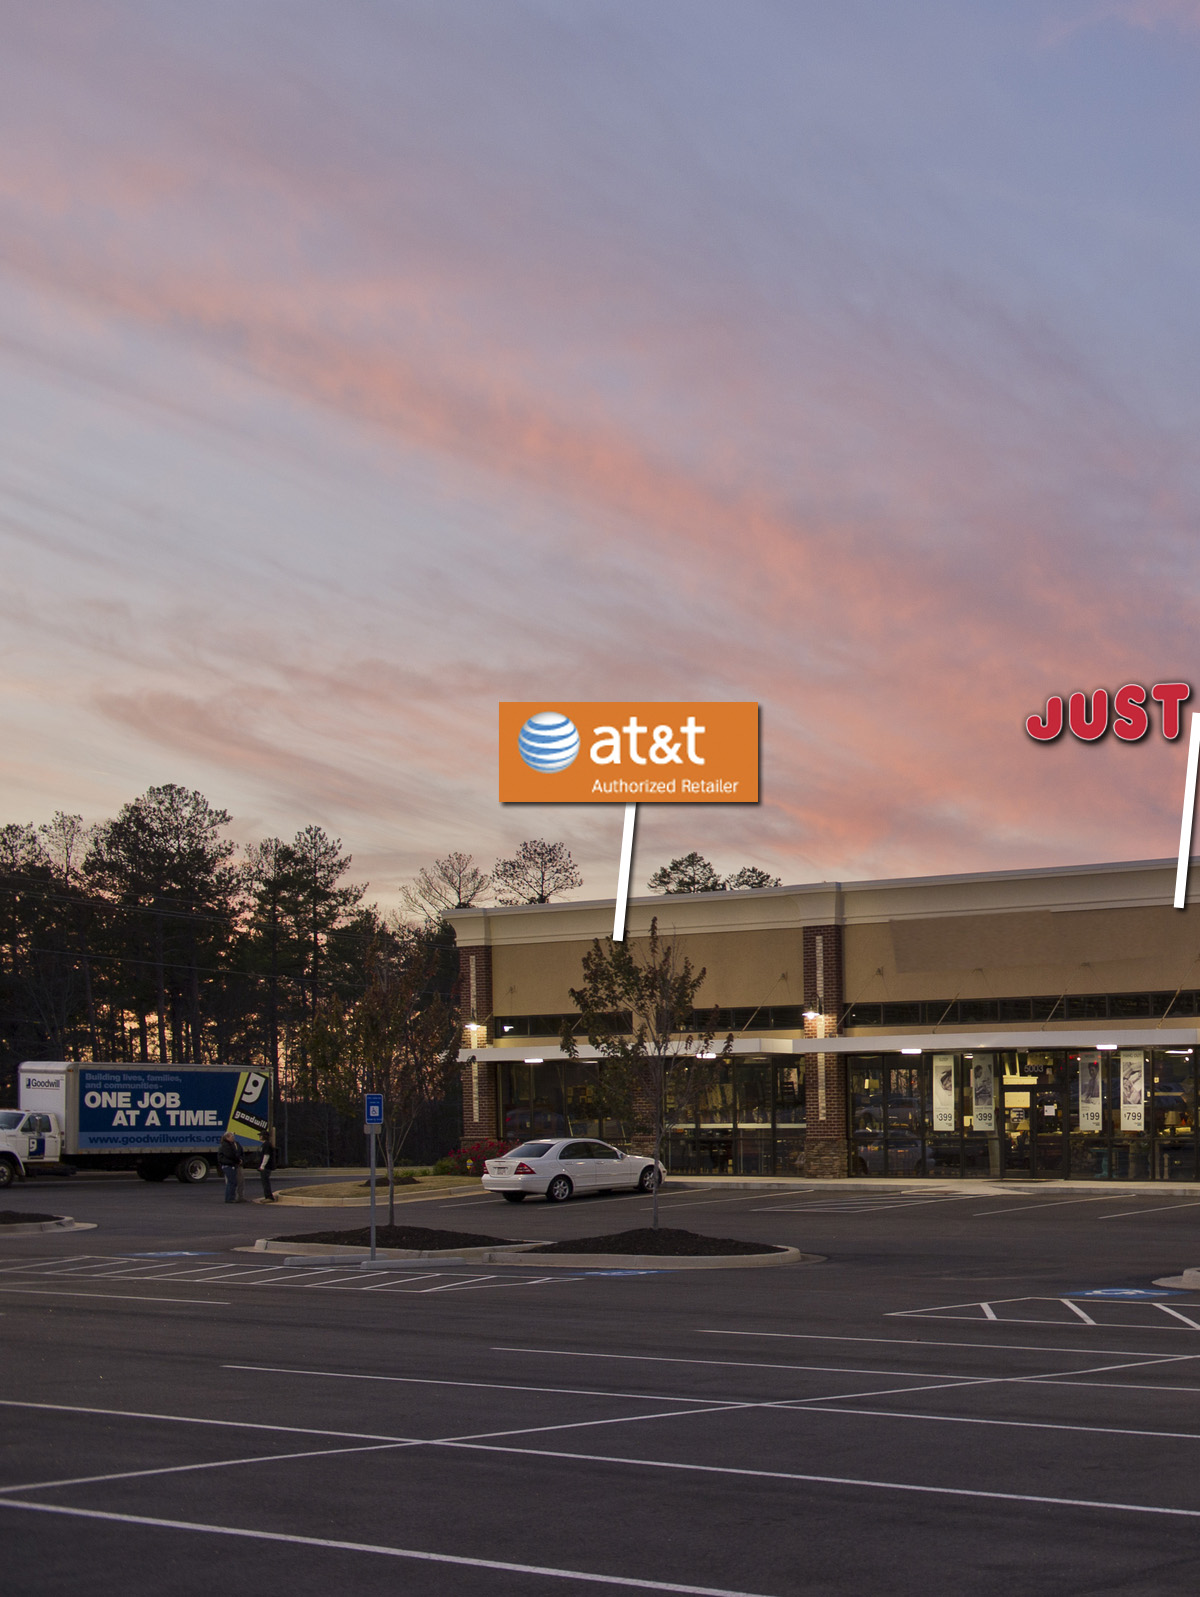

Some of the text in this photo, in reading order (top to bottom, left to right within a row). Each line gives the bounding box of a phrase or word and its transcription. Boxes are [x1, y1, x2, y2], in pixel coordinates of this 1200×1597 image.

[1023, 1064, 1044, 1073] 5003
[31, 1078, 60, 1088] Goodwill
[85, 1073, 182, 1083] Building lives, families,
[84, 1091, 181, 1109] ONE JOB
[112, 1110, 223, 1126] AT A TIME.
[234, 1110, 269, 1129] goodwill
[936, 1112, 952, 1121] $399
[976, 1112, 992, 1121] $399
[1082, 1112, 1099, 1121] $199
[1124, 1112, 1142, 1121] $799
[88, 1134, 222, 1146] www.goodwillworks.org
